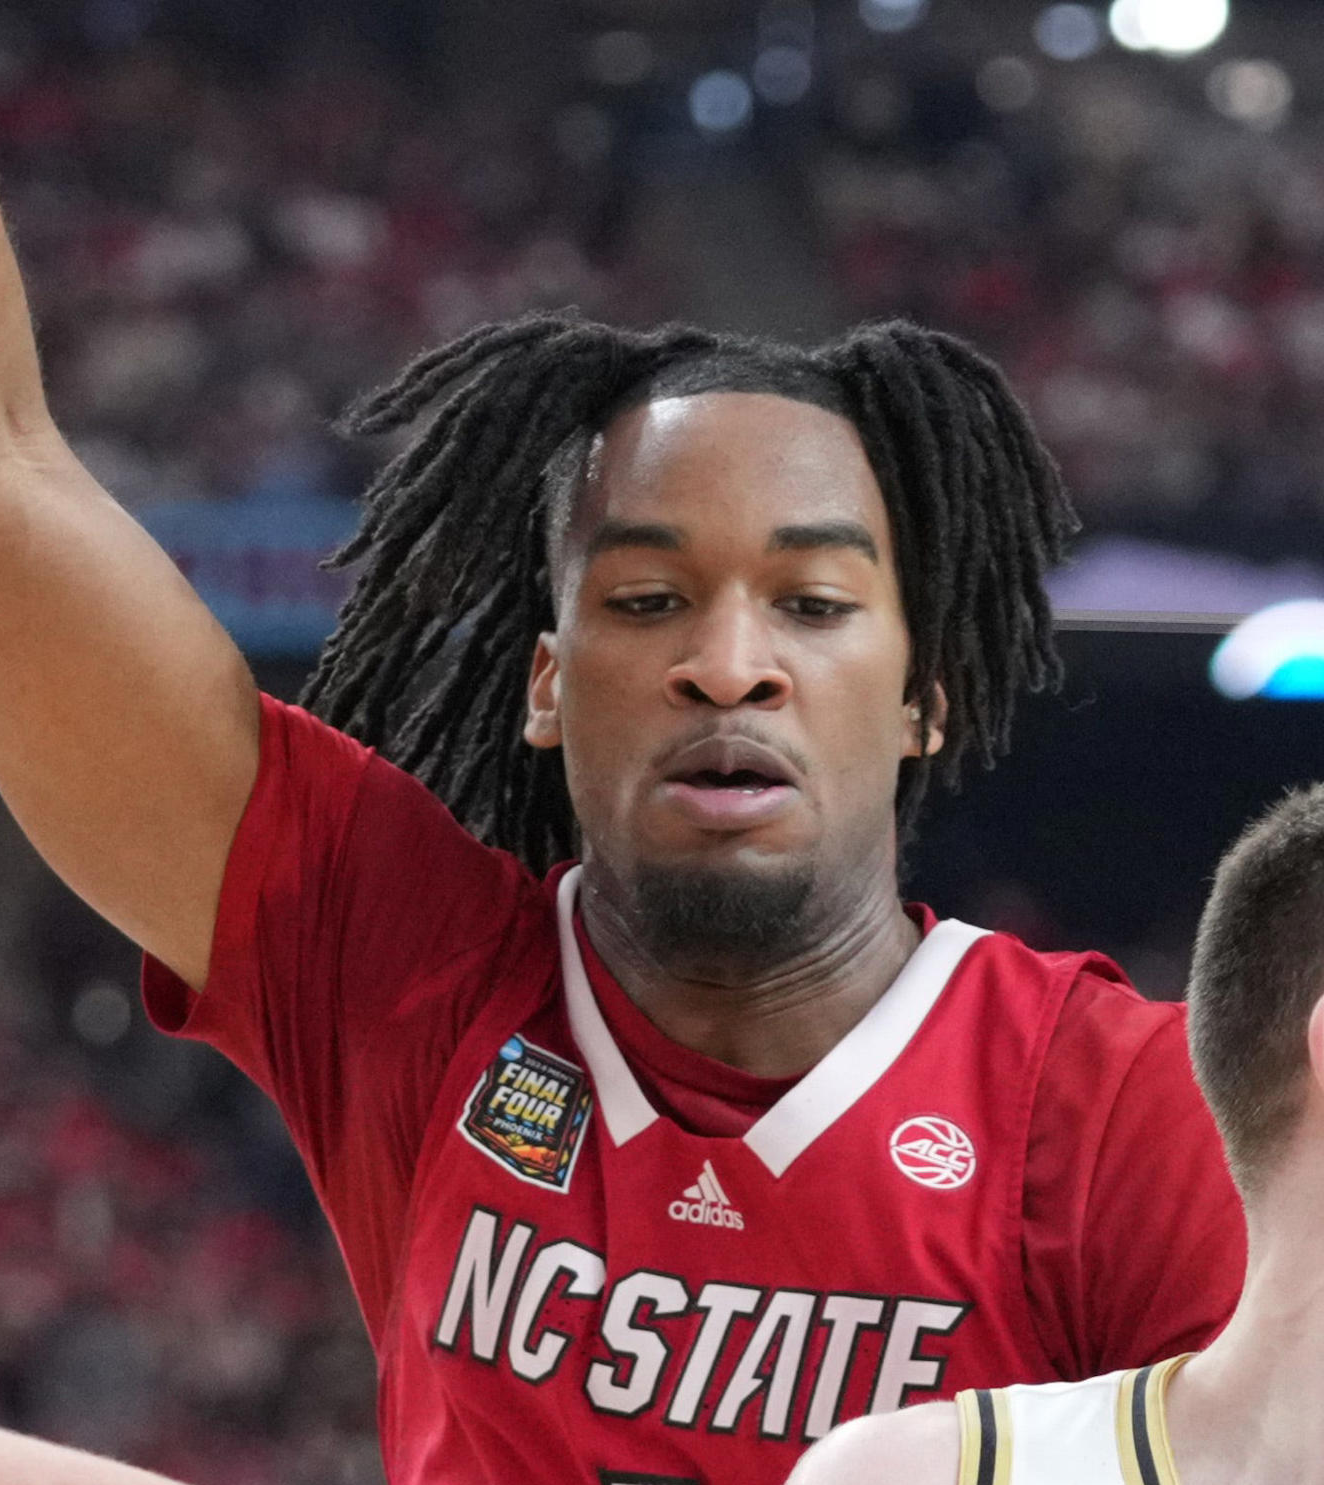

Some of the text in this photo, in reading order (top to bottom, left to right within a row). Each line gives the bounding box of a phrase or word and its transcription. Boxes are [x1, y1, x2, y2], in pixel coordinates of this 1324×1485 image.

[498, 1062, 571, 1108] FINAL
[489, 1085, 563, 1130] FOUR
[492, 1117, 544, 1142] PHOENIX
[898, 1138, 973, 1172] ACC
[668, 1199, 745, 1231] adidas
[433, 1203, 974, 1445] NC STATE
